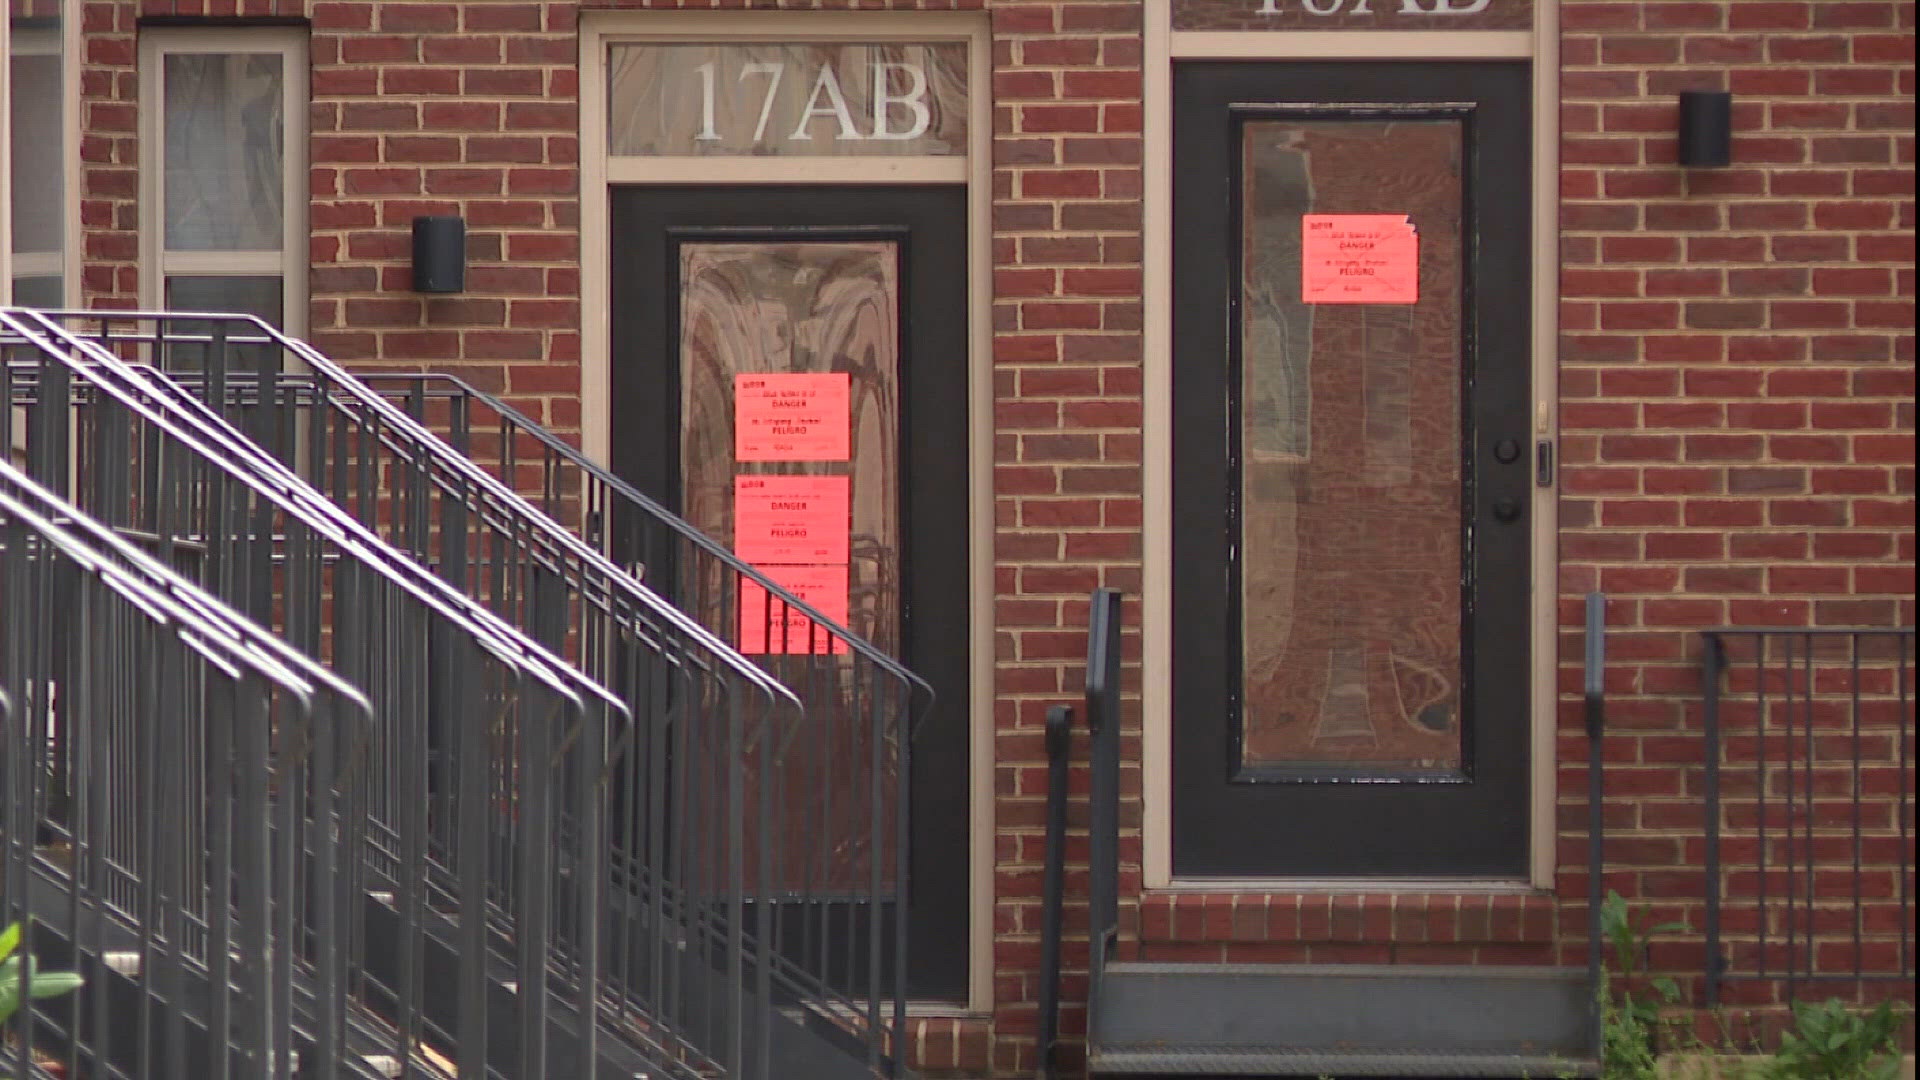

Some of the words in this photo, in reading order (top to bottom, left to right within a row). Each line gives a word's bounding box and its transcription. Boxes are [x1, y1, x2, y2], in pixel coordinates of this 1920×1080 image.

[694, 60, 931, 141] 17AB
[1339, 242, 1375, 250] DANGER
[772, 427, 807, 435] PELIGRO
[770, 502, 807, 511] DANGER
[770, 530, 807, 538] PELIGRO
